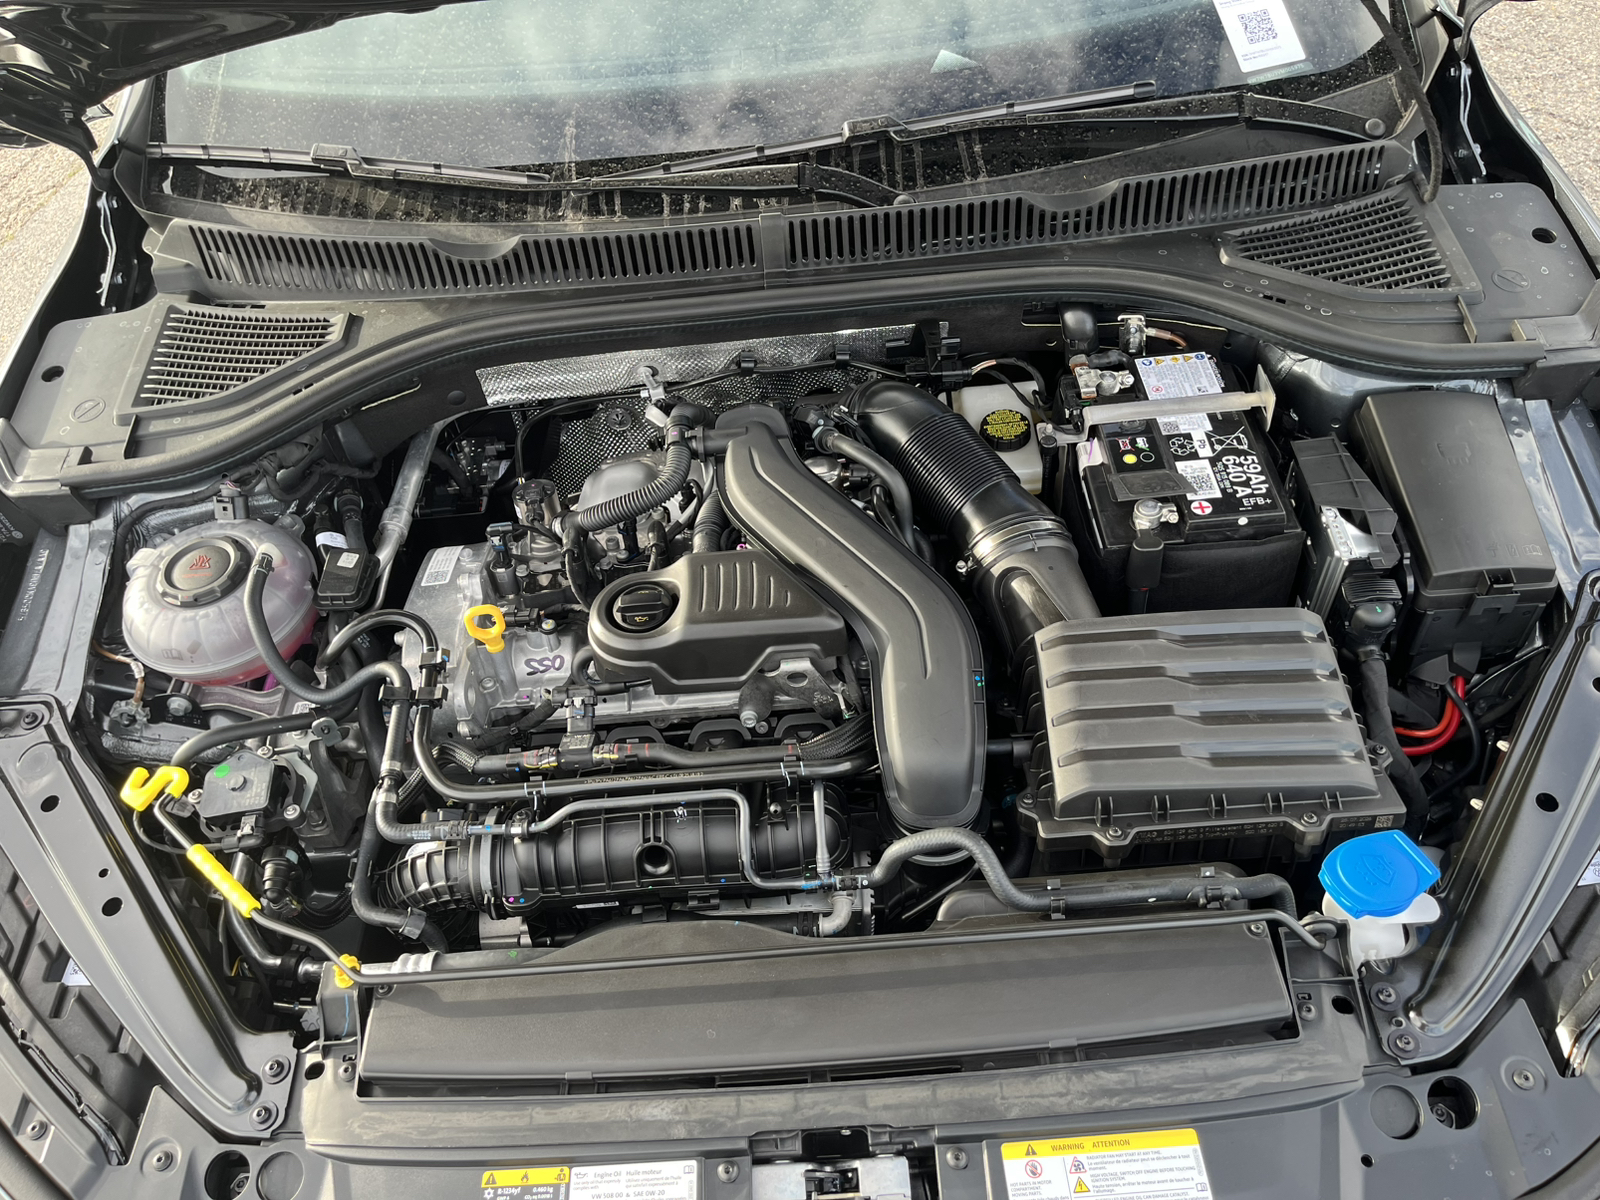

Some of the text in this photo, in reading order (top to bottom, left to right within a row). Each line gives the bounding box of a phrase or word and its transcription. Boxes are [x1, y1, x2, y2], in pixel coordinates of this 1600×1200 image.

[1197, 439, 1207, 449] Pb
[1222, 455, 1247, 482] 640
[1240, 456, 1269, 494] 59Ah
[1233, 486, 1252, 498] A
[1242, 497, 1272, 506] EFB+
[1051, 1139, 1130, 1152] WARNING ATTENTION
[498, 1186, 521, 1195] R-1234yf
